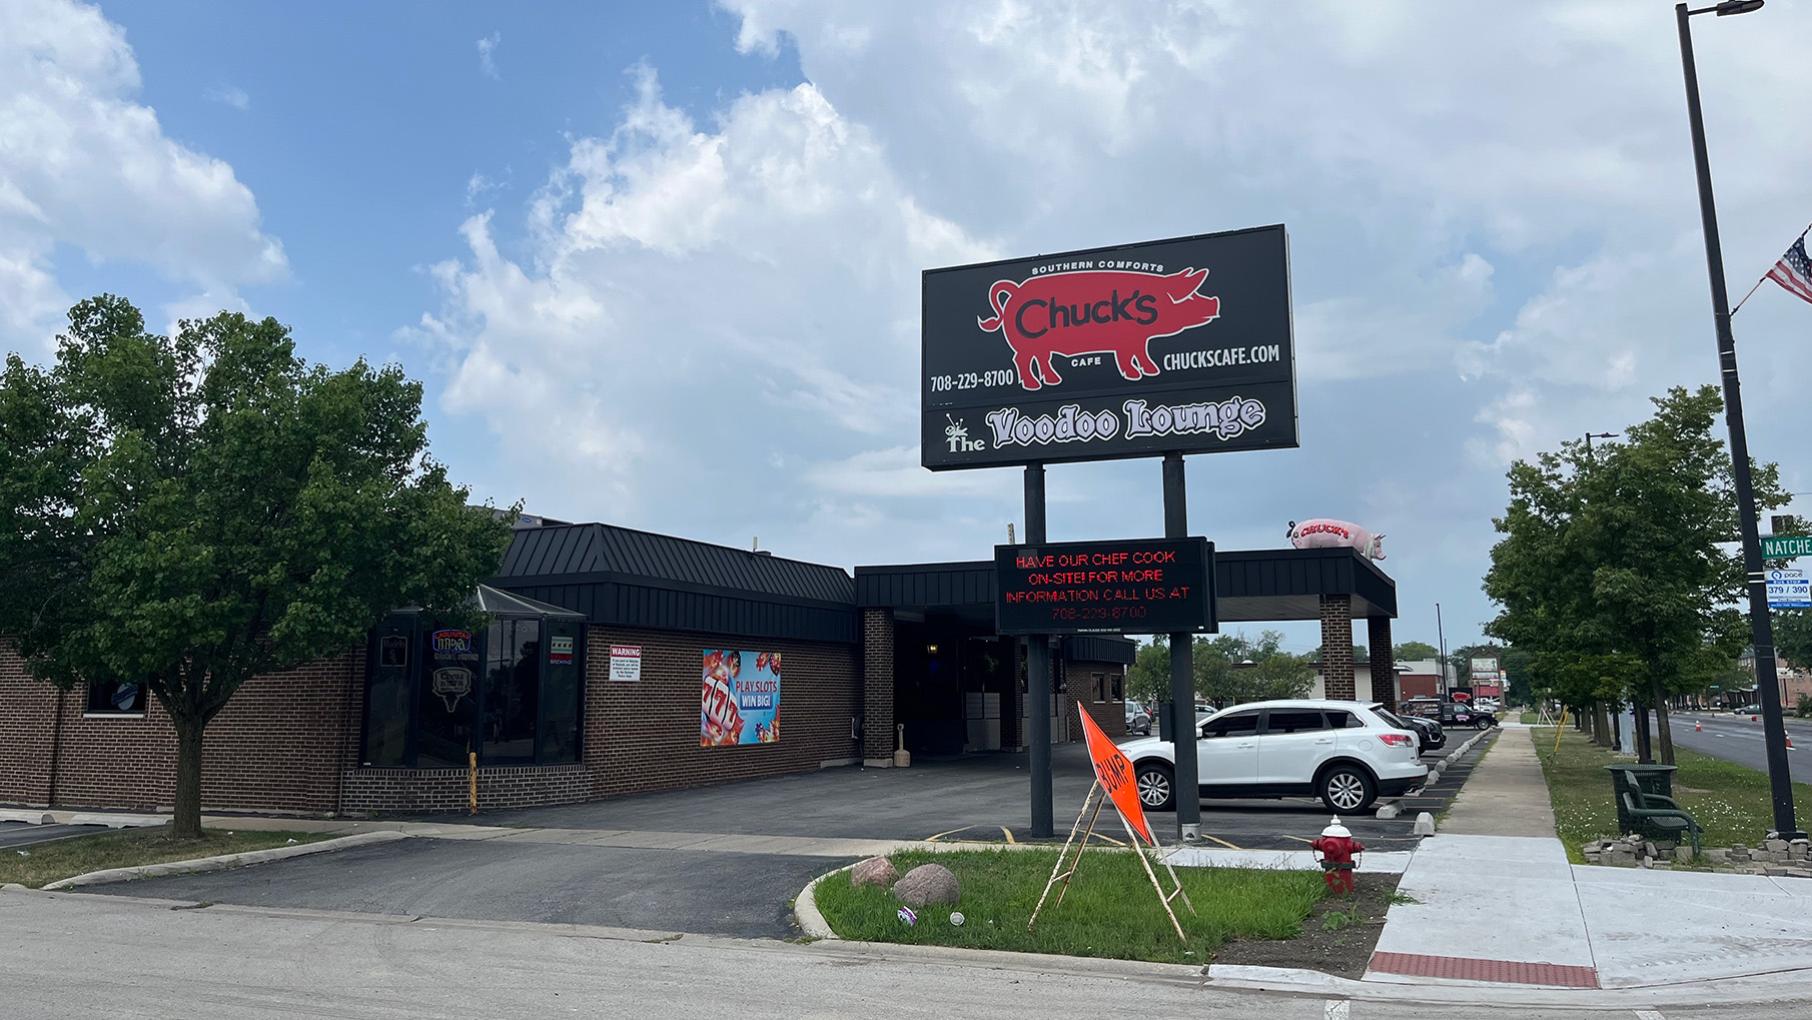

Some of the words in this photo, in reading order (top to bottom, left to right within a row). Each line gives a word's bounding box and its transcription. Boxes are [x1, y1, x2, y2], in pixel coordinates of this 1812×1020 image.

[1031, 260, 1094, 275] SOUTHERN
[1098, 260, 1164, 273] COMFORTS
[1015, 289, 1158, 339] Chuck's
[1071, 357, 1102, 368] CAFE
[1163, 344, 1280, 371] CHUCKSCAFE.COM
[930, 369, 1014, 392] 708-229-8700
[947, 434, 985, 453] The
[985, 404, 1120, 449] Voodoo
[1123, 395, 1267, 441] Lounge
[1765, 539, 1812, 556] NATCHE
[1016, 555, 1054, 569] HAVE
[1058, 554, 1089, 567] OUR
[1091, 552, 1129, 566] CHEF
[1132, 551, 1176, 564] COOK
[1088, 570, 1118, 584] FOR
[1121, 569, 1164, 583] MORE
[1006, 589, 1099, 604] INFORMATION
[1103, 588, 1140, 601] CALL
[1145, 587, 1166, 600] US
[1169, 586, 1190, 600] AT
[1768, 586, 1784, 594] 379
[612, 647, 640, 657] WARNING
[736, 681, 755, 693] PLAY
[755, 681, 778, 693] SLOTS
[741, 695, 757, 708] WIN
[757, 695, 771, 707] BIG!
[1095, 753, 1129, 794] BUMP
